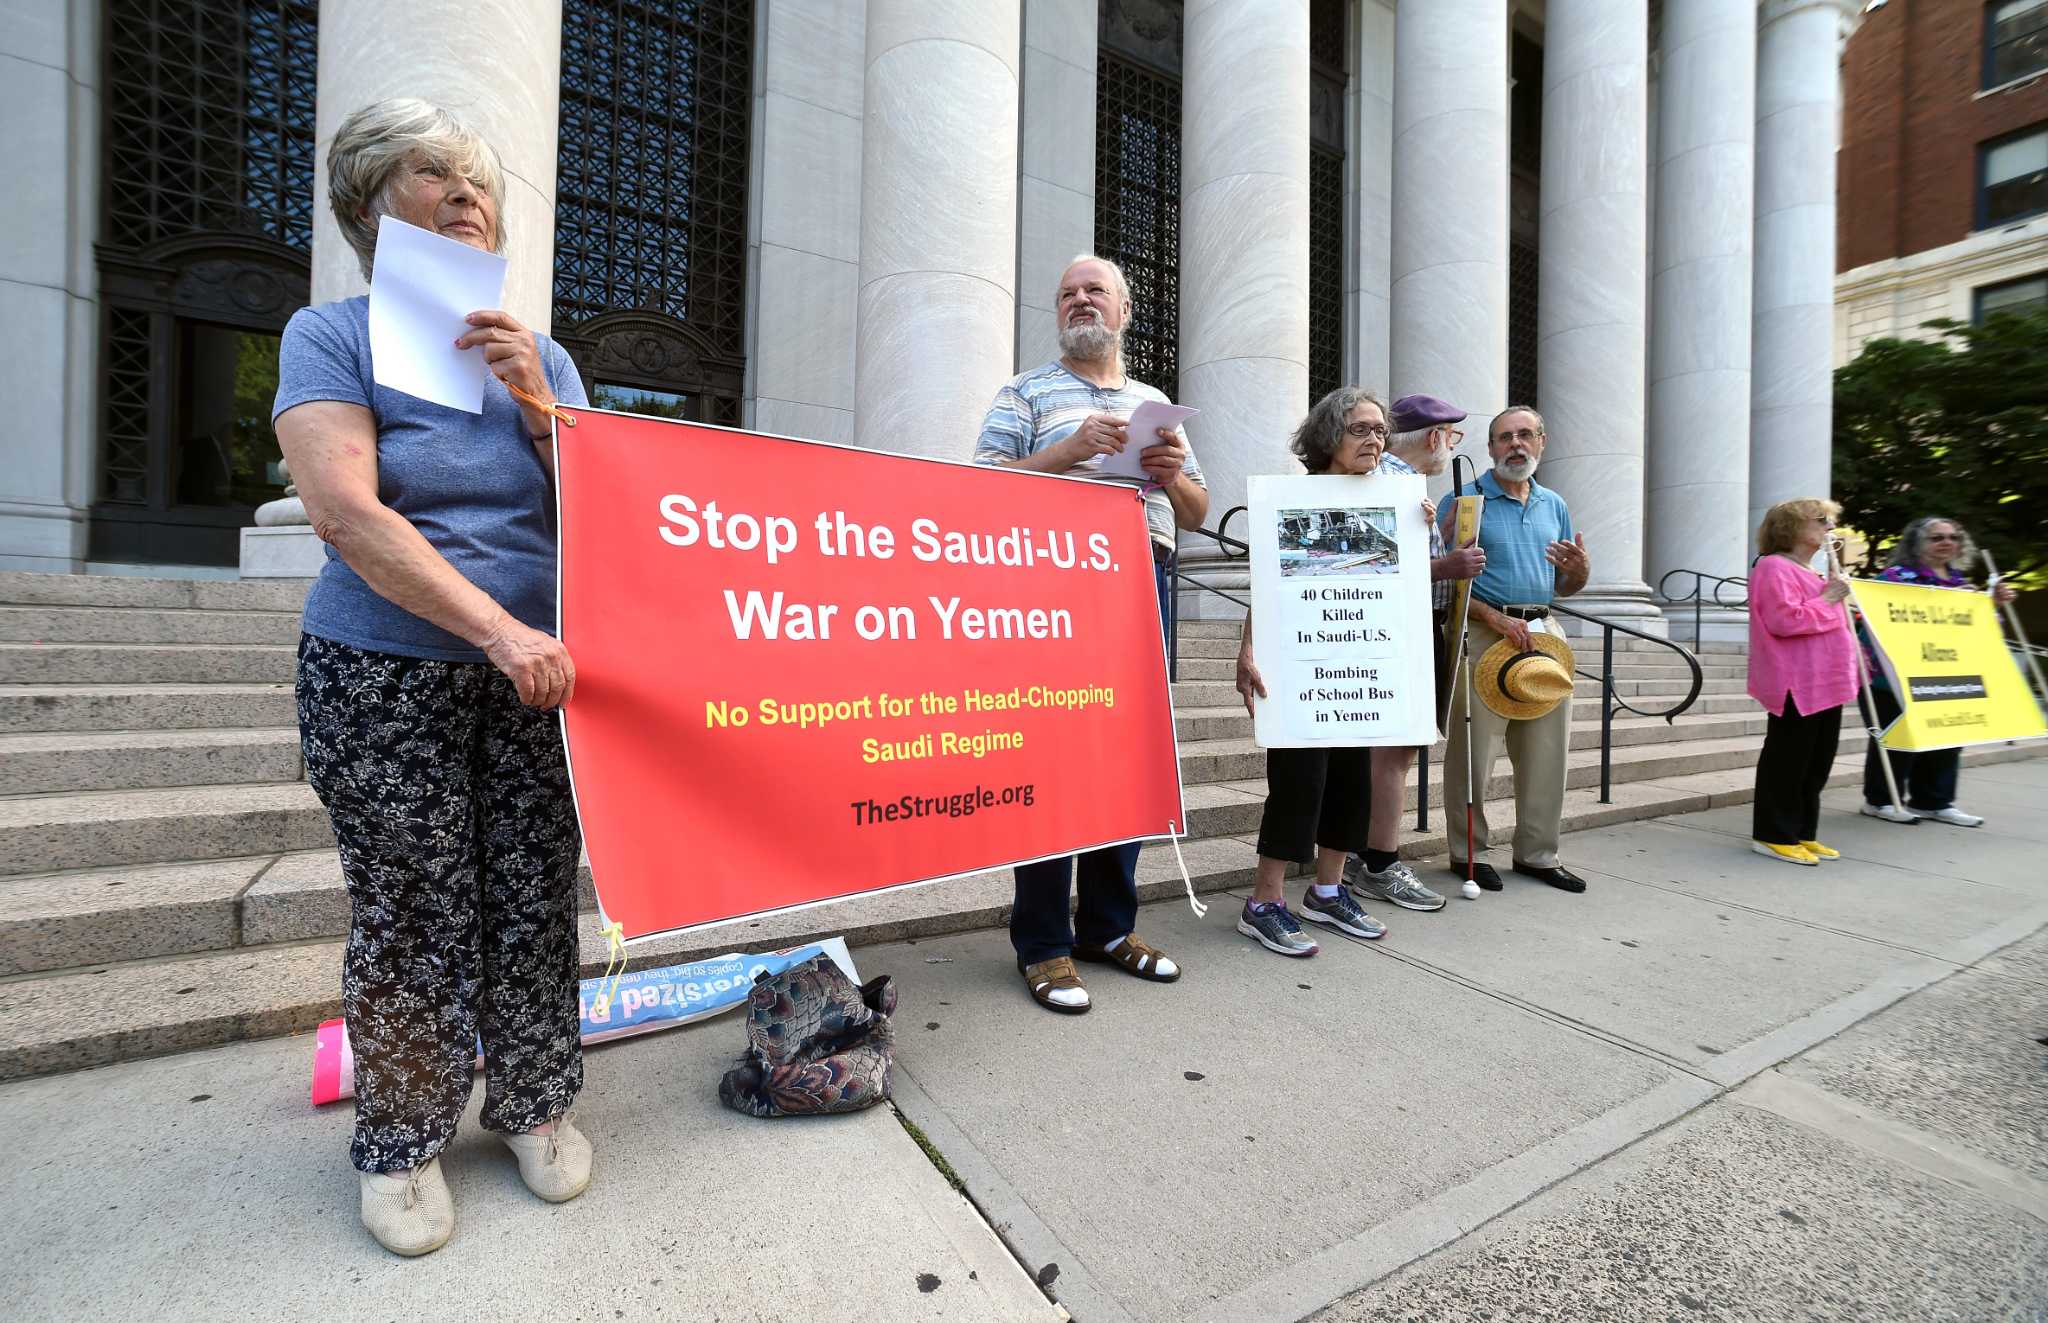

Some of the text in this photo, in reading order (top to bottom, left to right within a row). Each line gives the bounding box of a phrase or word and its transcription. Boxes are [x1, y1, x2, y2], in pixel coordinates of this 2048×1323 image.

[658, 494, 1121, 573] Stop the Saudi-U.S.
[1300, 588, 1383, 601] 40 Children
[722, 590, 1073, 641] War on Yemen
[1322, 608, 1364, 621] Killed
[1297, 629, 1392, 643] In Saudi-U.S.
[1314, 666, 1378, 682] Bombing
[1299, 687, 1395, 701] of School Bus
[705, 684, 1115, 729] No Support for the Head-Chopping
[1315, 709, 1380, 723] in Yemen
[862, 729, 1024, 764] Saudi Regime
[851, 783, 1035, 826] TheStruggle.org
[643, 970, 670, 981] they
[703, 961, 744, 976] Copies
[579, 979, 597, 992] sp
[611, 975, 641, 988] nee
[579, 994, 611, 1024] P
